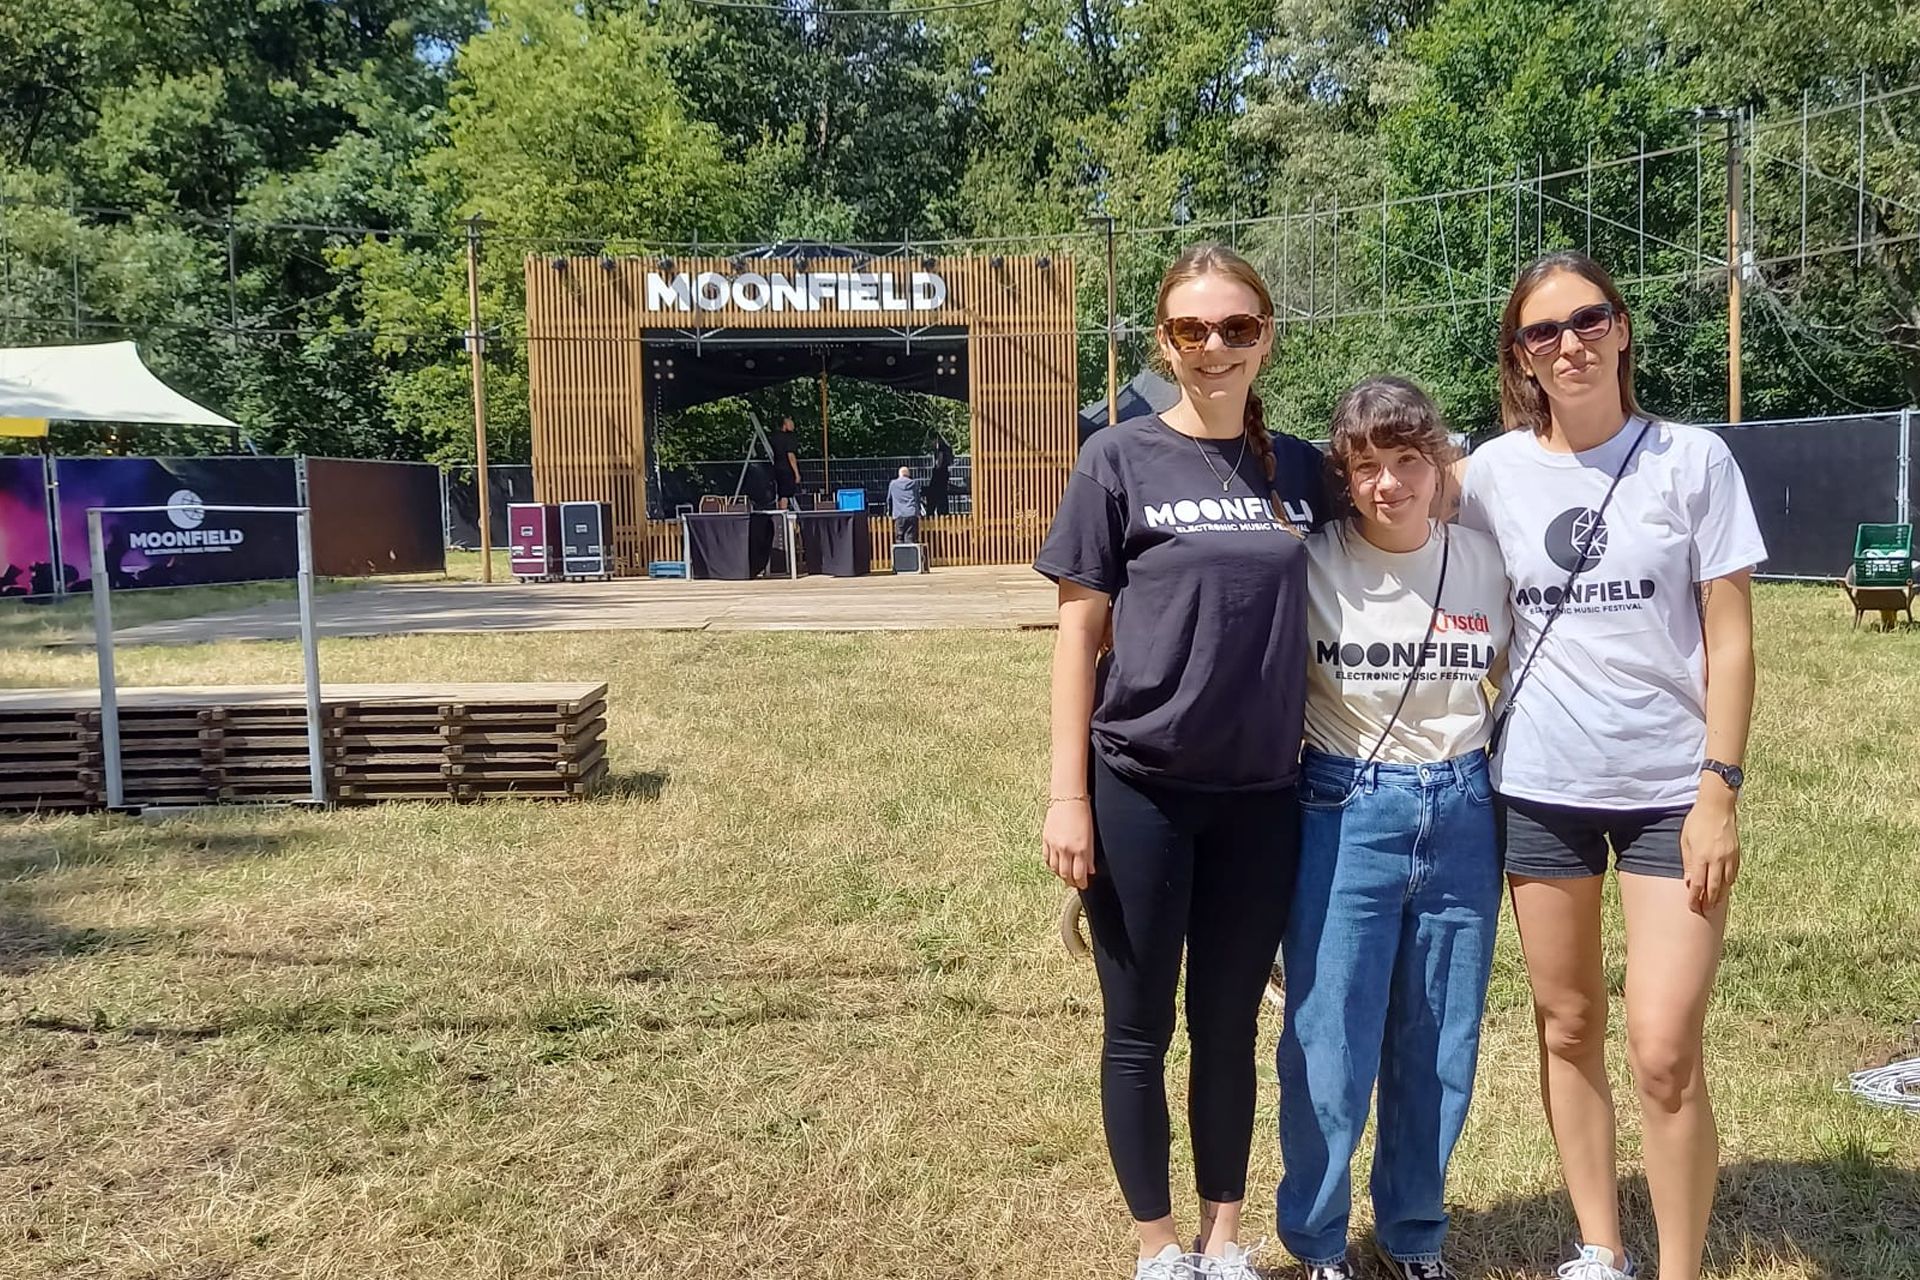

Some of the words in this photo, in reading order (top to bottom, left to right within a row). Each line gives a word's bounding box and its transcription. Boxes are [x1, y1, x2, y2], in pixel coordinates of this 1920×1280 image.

[647, 272, 946, 311] MOONFIELD
[1144, 497, 1313, 527] MOONFIL
[130, 530, 243, 548] MOONFIELD
[1574, 606, 1600, 614] MUSIC
[1603, 603, 1643, 612] FESTIVAL
[1335, 671, 1400, 681] ELECTRONIC
[1402, 672, 1438, 681] MUSIC
[1440, 672, 1480, 682] FESTIV
